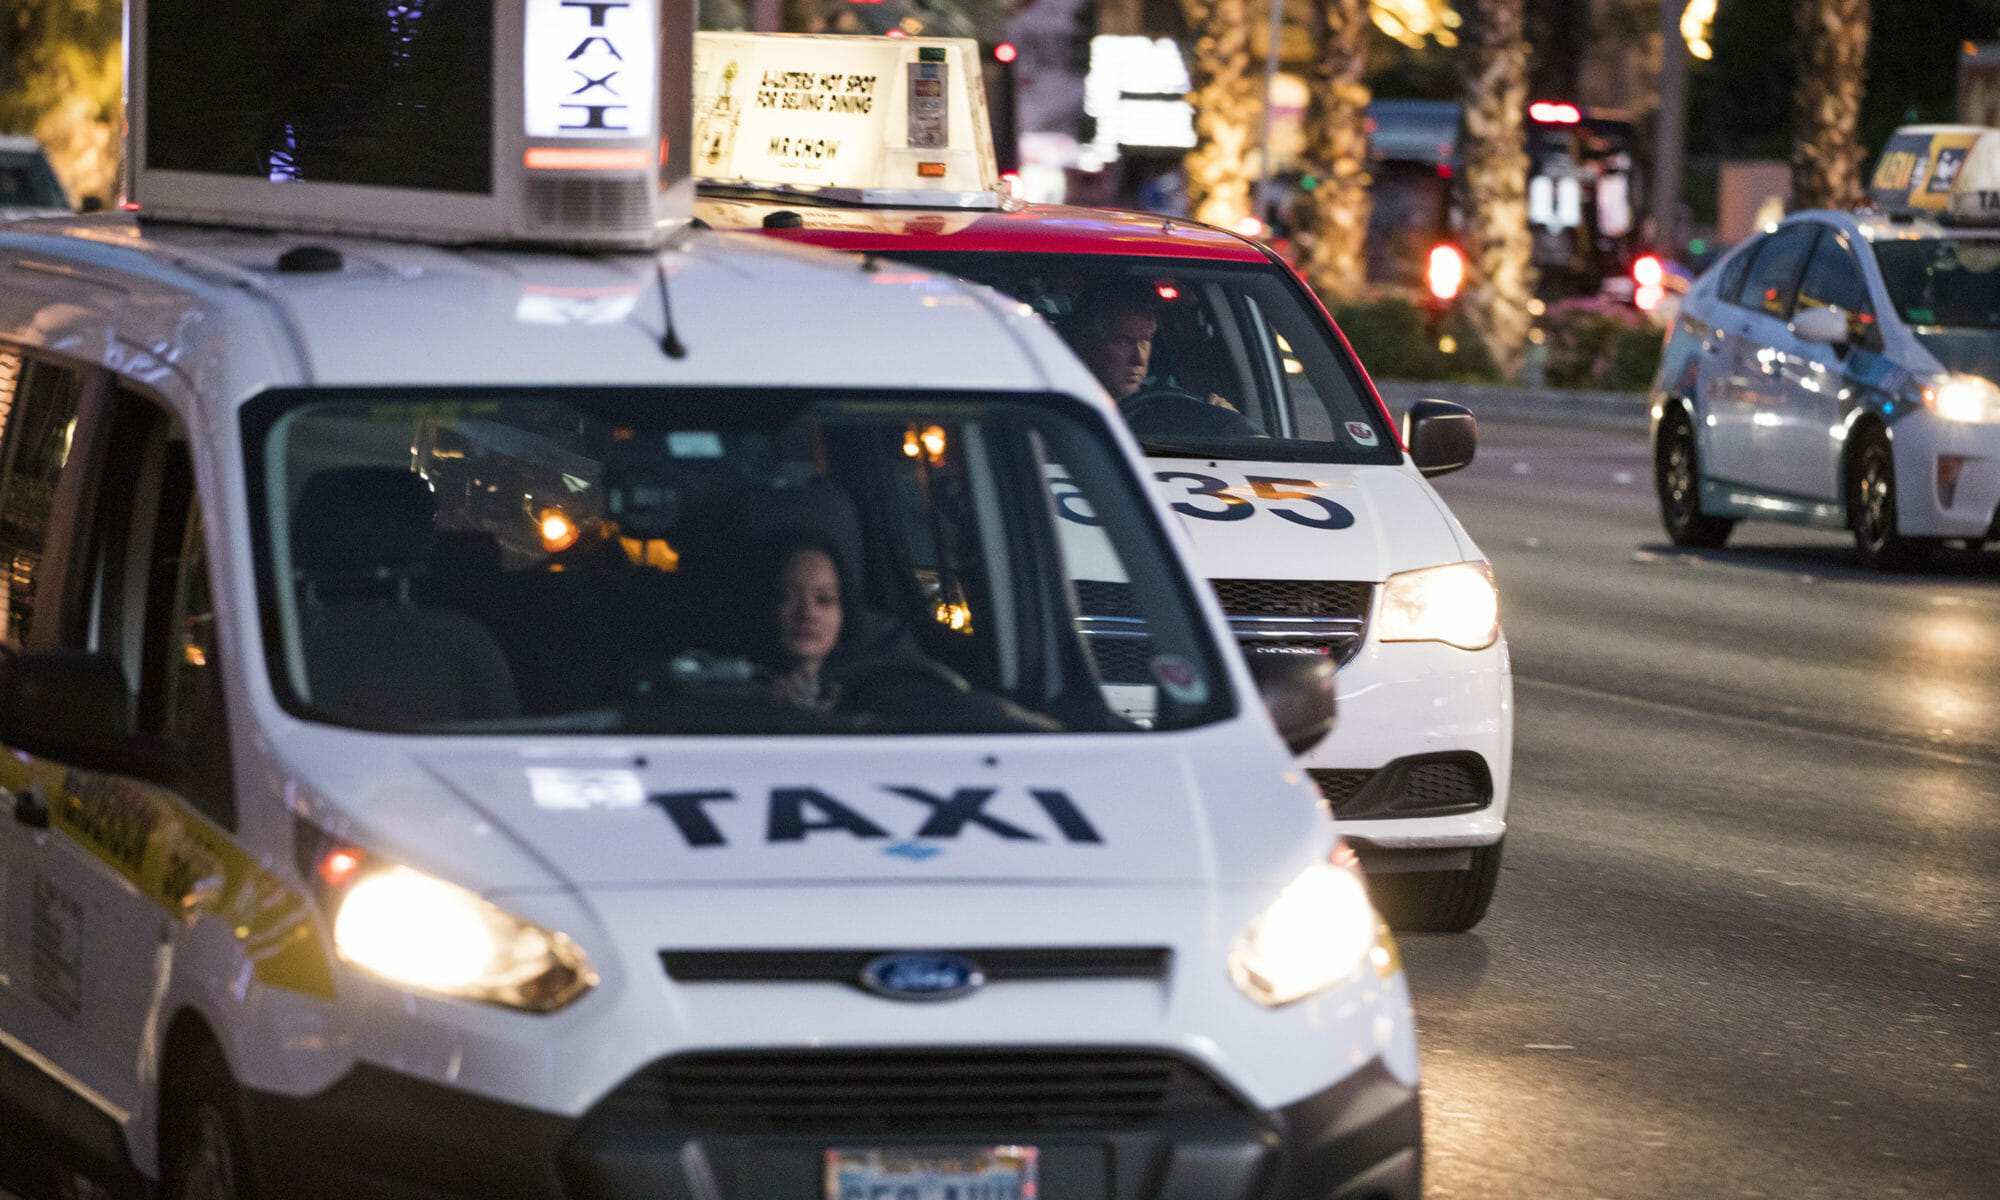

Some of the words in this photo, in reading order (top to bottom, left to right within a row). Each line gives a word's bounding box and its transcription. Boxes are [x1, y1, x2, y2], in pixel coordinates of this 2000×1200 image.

[558, 1, 630, 131] TAXI
[819, 73, 842, 92] HOT
[845, 74, 877, 95] SPOT
[755, 91, 777, 109] FOR
[828, 94, 873, 114] DINING
[767, 136, 789, 157] MR
[794, 137, 840, 160] CHOW
[646, 784, 1105, 848] TAXI
